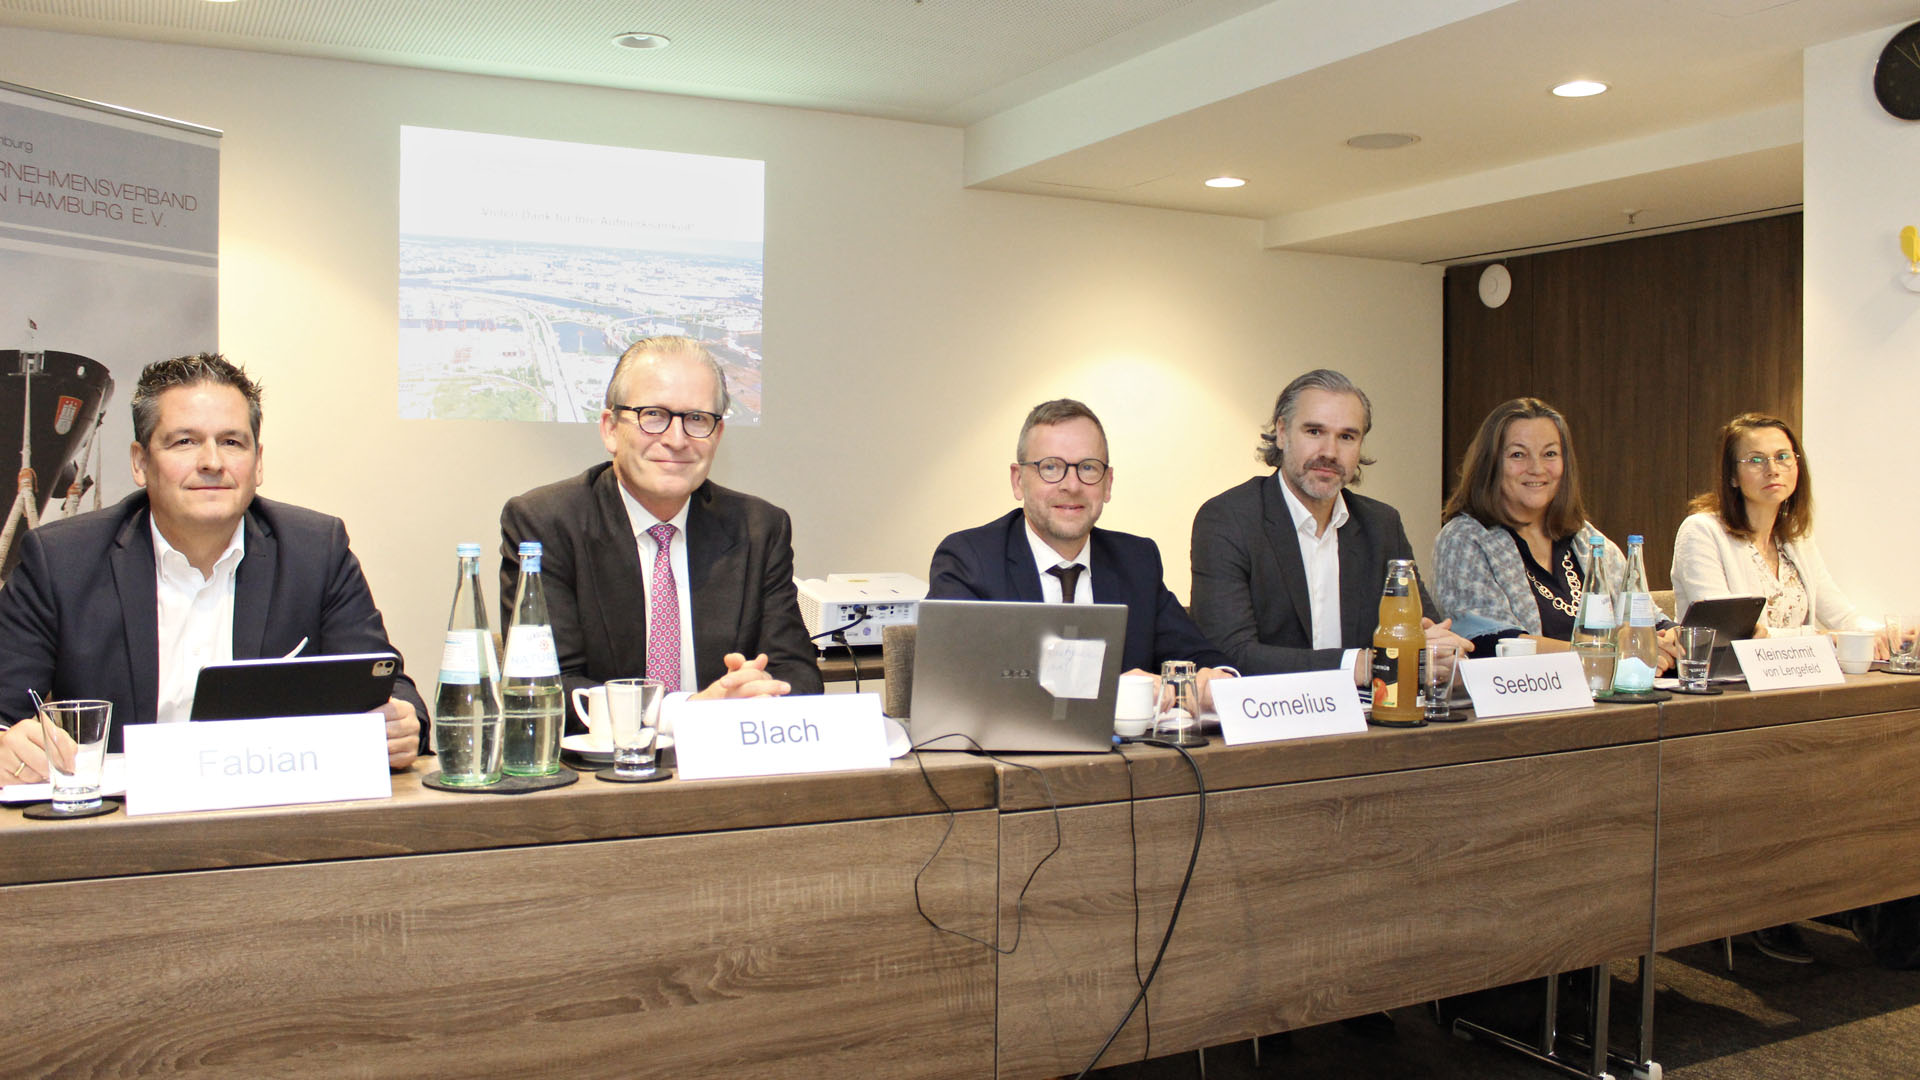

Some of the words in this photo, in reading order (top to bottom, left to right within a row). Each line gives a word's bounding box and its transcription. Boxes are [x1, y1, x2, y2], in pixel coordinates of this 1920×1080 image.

[18, 187, 123, 221] HAMBURG
[132, 208, 167, 227] E.V.
[1754, 645, 1816, 661] Kleinschmit
[1492, 671, 1562, 695] Seebold
[1763, 667, 1779, 677] von
[1779, 664, 1821, 677] Lengefeld
[1242, 693, 1337, 719] Cornelius
[739, 718, 820, 746] Blach
[199, 746, 319, 777] Fabian
